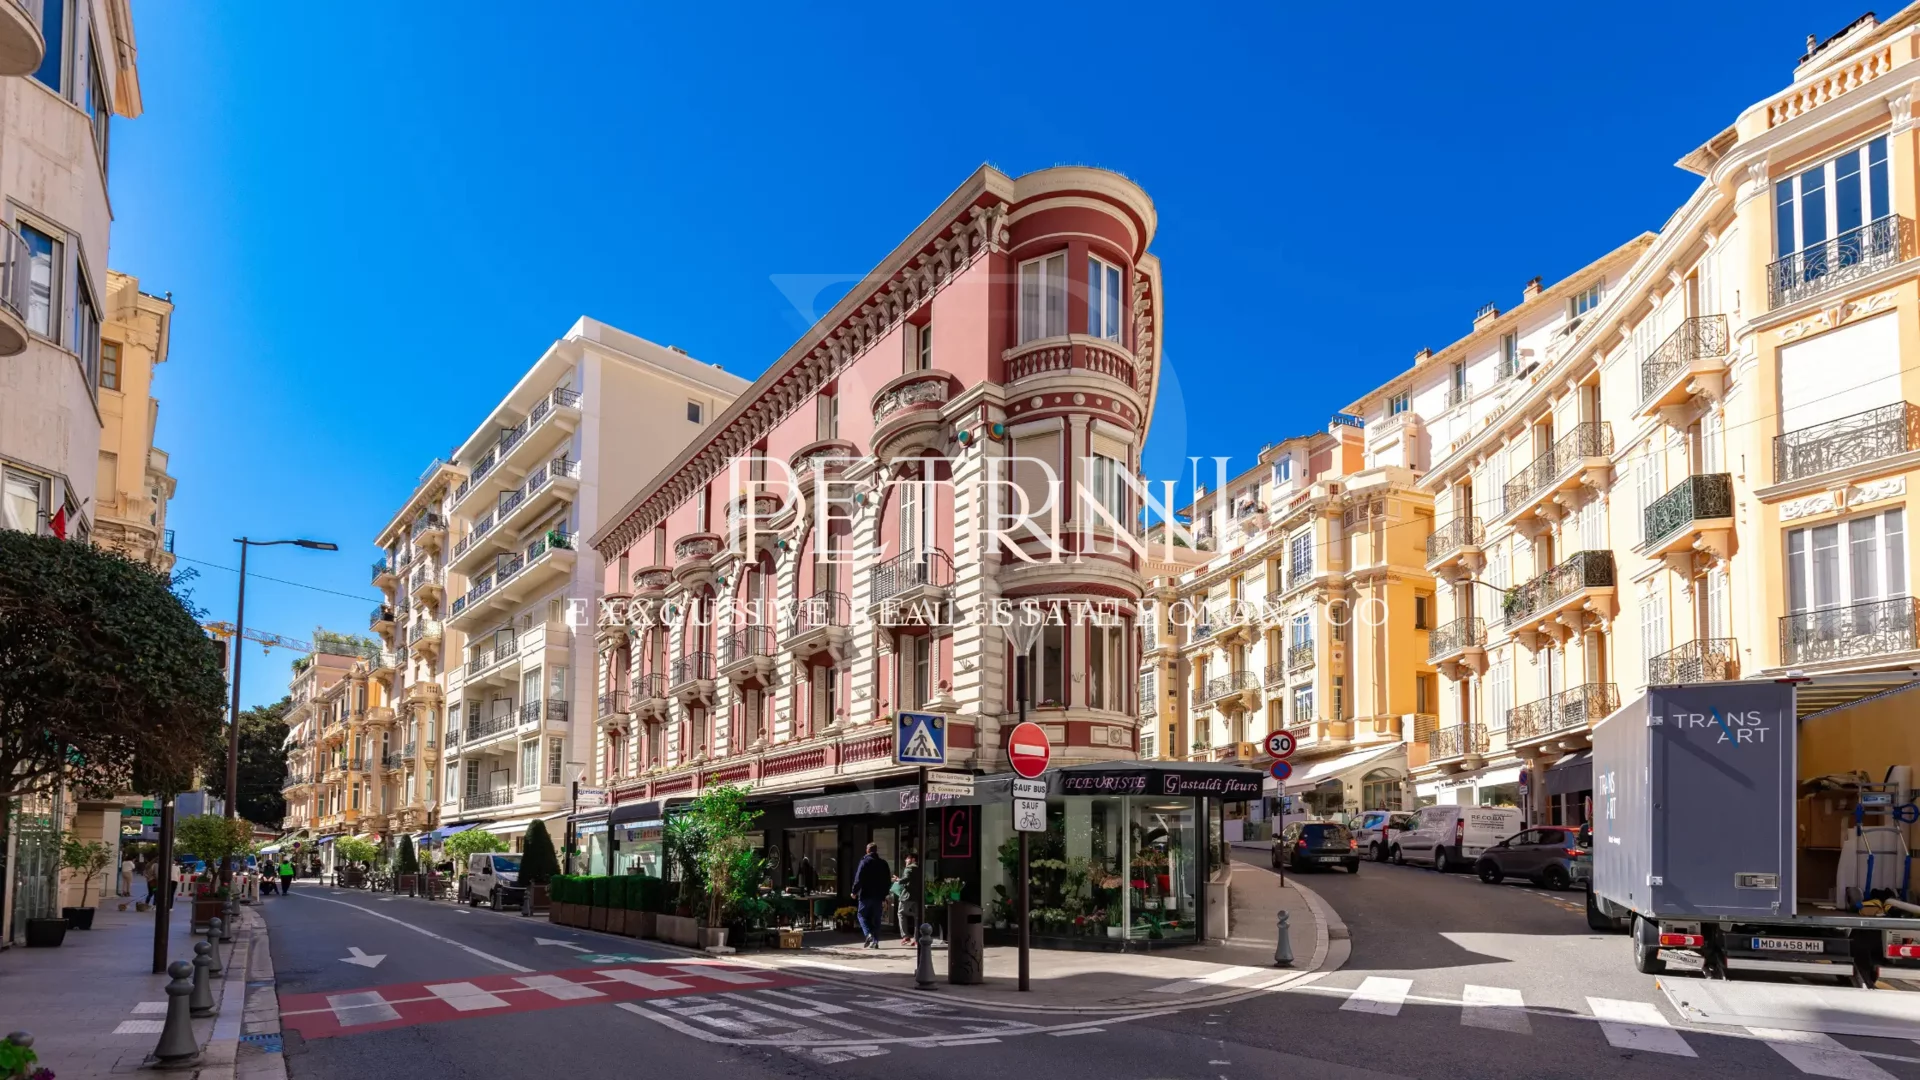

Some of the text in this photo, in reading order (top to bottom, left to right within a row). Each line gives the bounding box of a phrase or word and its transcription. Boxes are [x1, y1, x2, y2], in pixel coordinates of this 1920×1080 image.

[1673, 711, 1762, 729] TRANS
[1716, 728, 1770, 744] ART
[1271, 738, 1291, 751] 30
[1013, 783, 1046, 795] SAUF BUS
[1065, 775, 1147, 790] FLEURISTE
[1165, 775, 1258, 794] Gastaldi fleurs
[1021, 801, 1039, 811] SAUF
[949, 810, 965, 847] G
[1760, 939, 1820, 951] MD 458 MH
